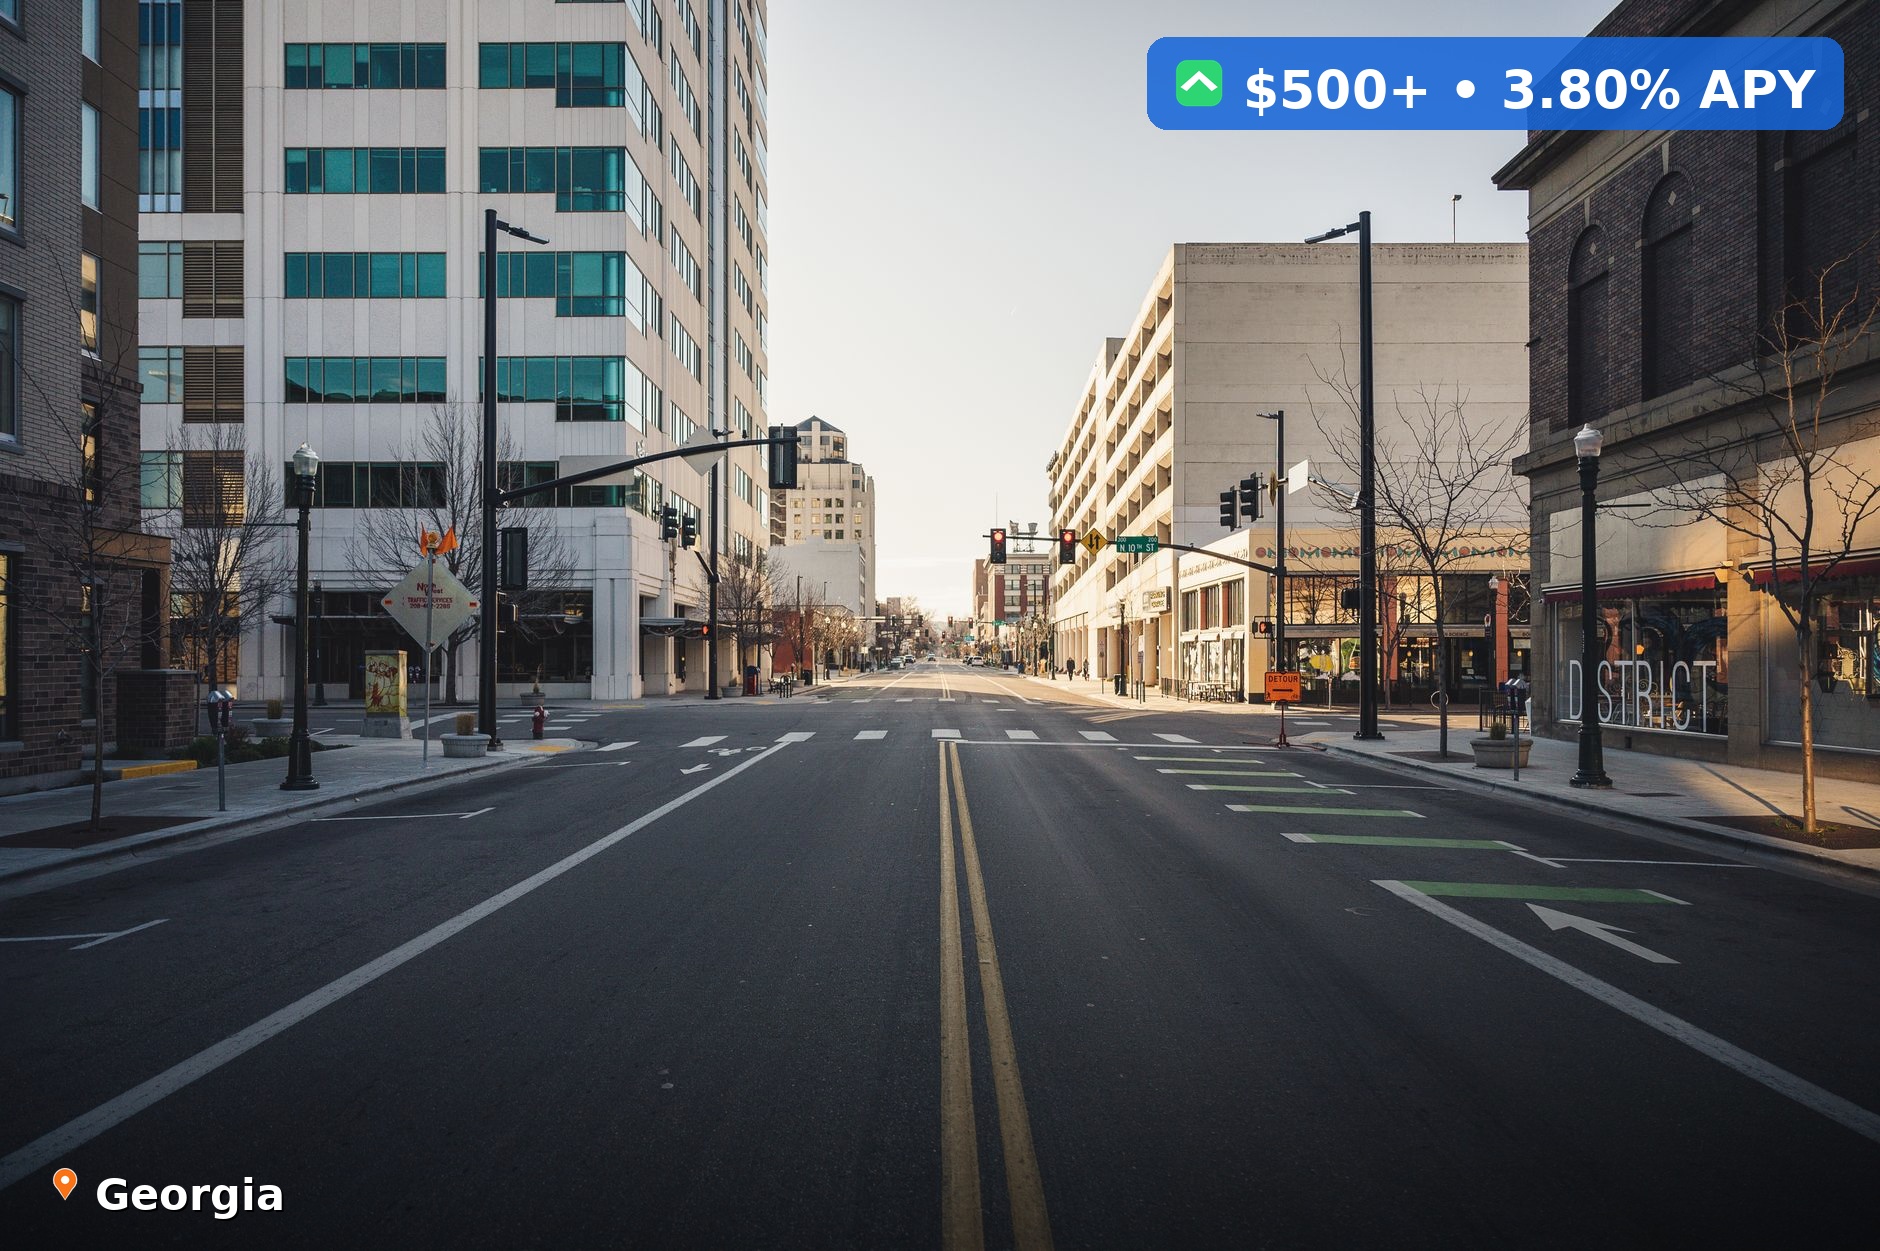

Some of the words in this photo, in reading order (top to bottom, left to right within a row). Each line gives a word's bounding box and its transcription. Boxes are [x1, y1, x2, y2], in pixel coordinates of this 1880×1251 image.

[1119, 543, 1125, 552] N
[1145, 543, 1155, 552] ST
[1268, 675, 1299, 683] DETOUR
[1569, 660, 1717, 732] DSTRICT
